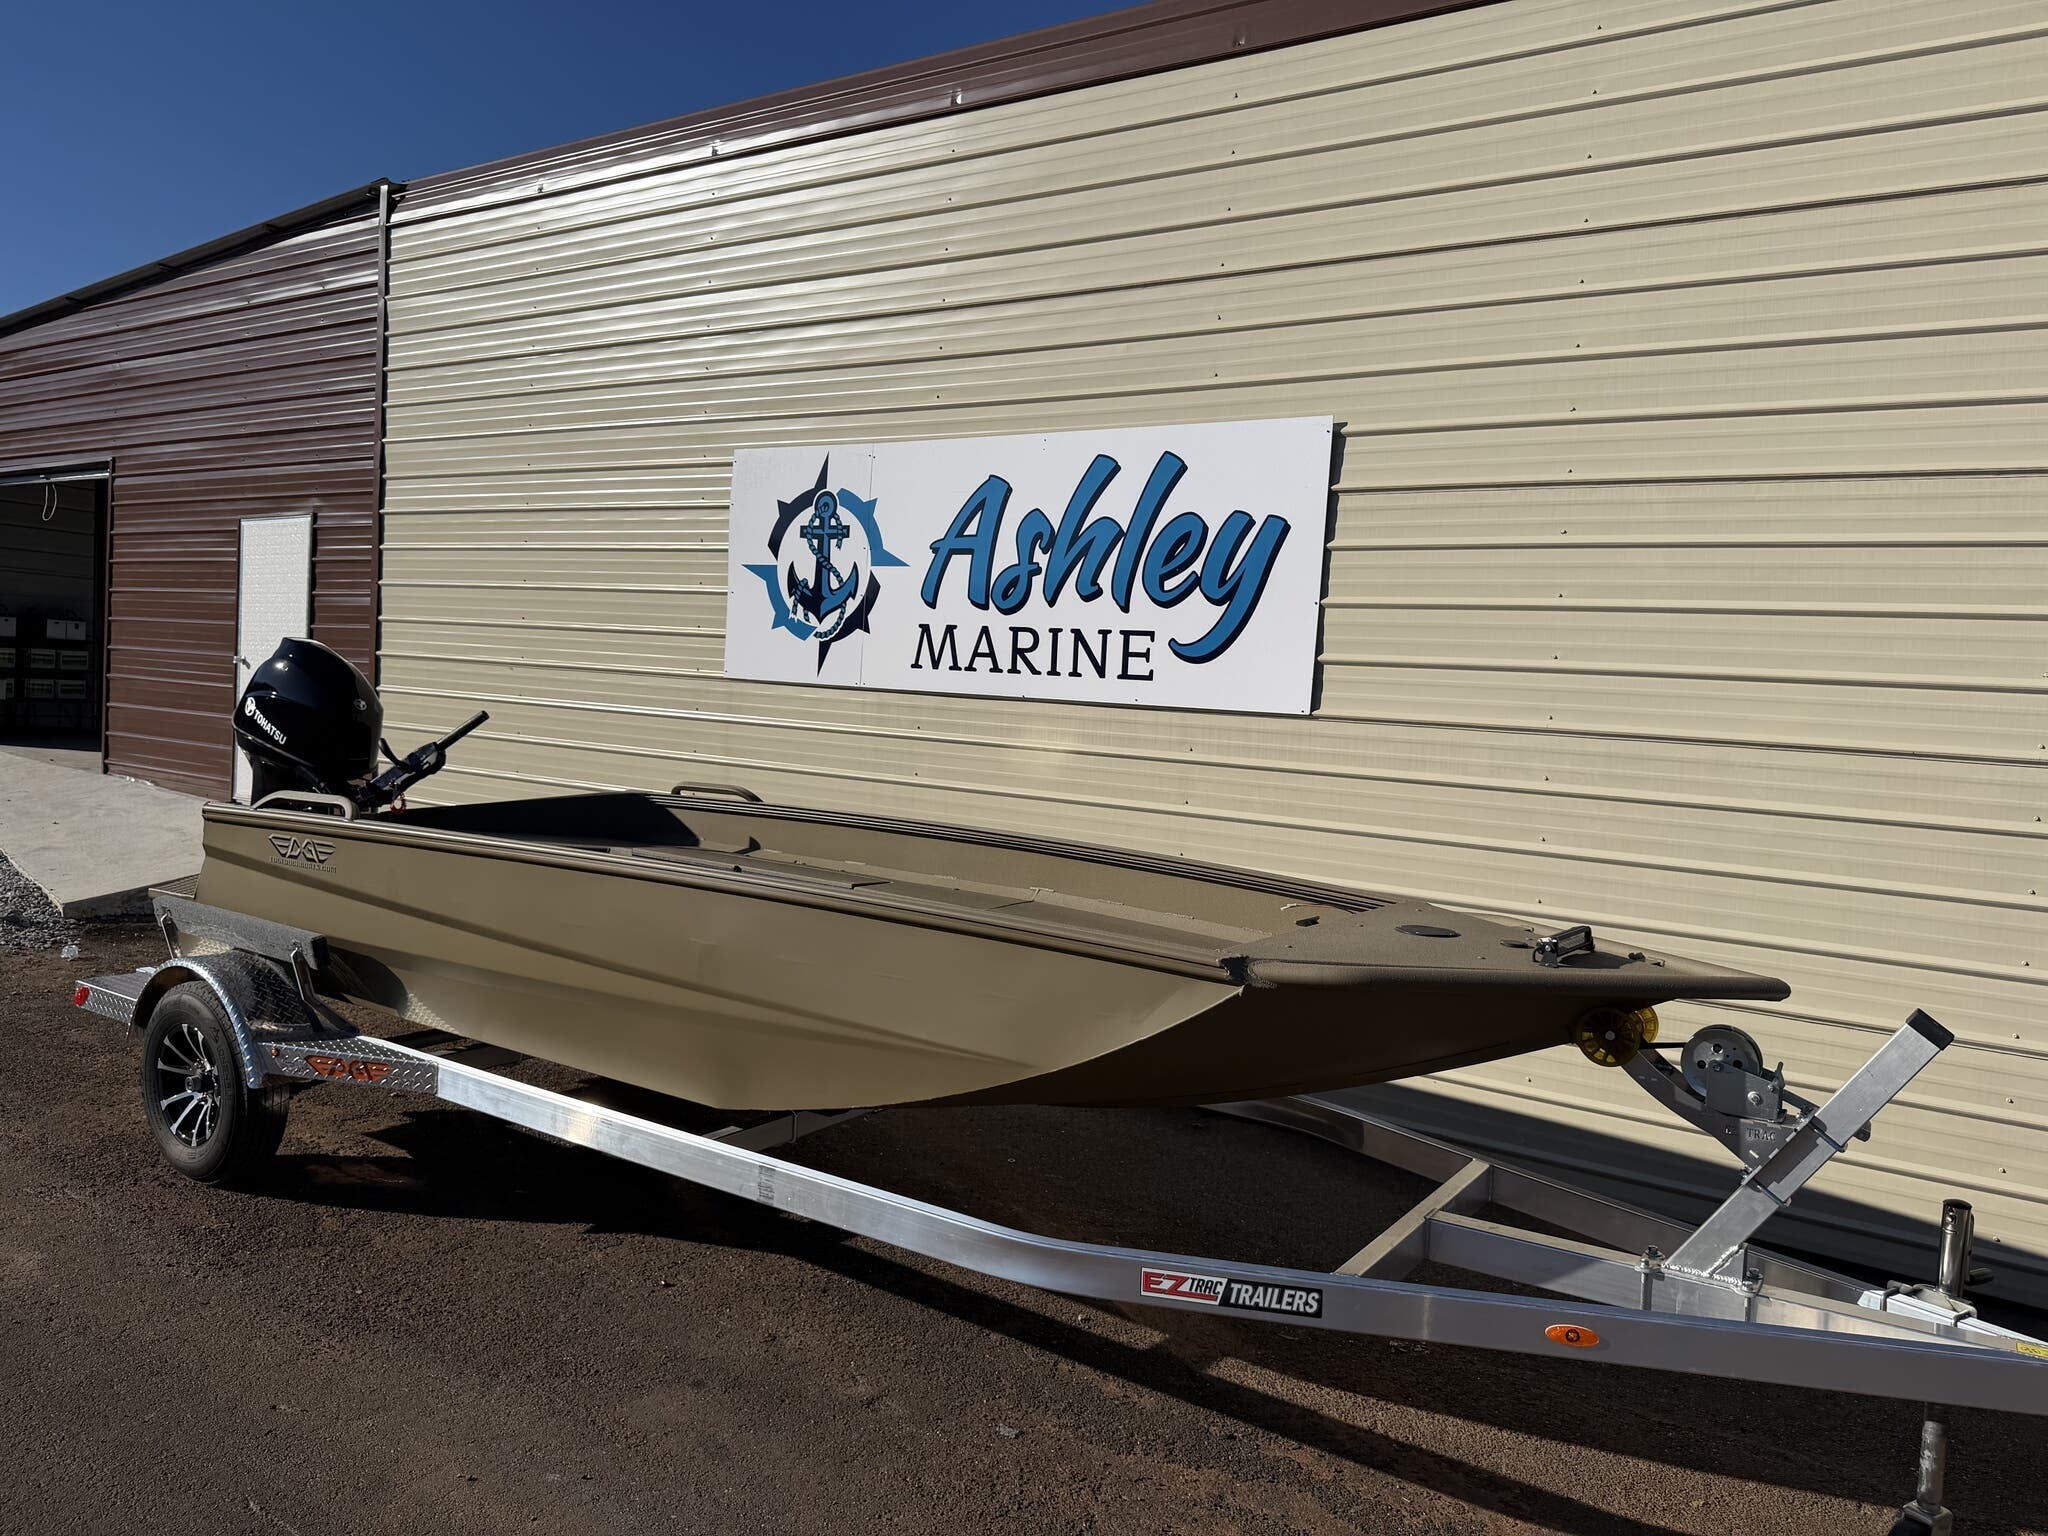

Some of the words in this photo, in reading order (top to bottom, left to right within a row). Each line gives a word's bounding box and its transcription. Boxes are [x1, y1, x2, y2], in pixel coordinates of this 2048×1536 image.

[920, 450, 1290, 665] Ashley
[910, 623, 1156, 682] MARINE
[253, 709, 287, 744] TOHATSU
[1188, 1276, 1221, 1295] TRAC
[1229, 1282, 1320, 1314] TRAILERS
